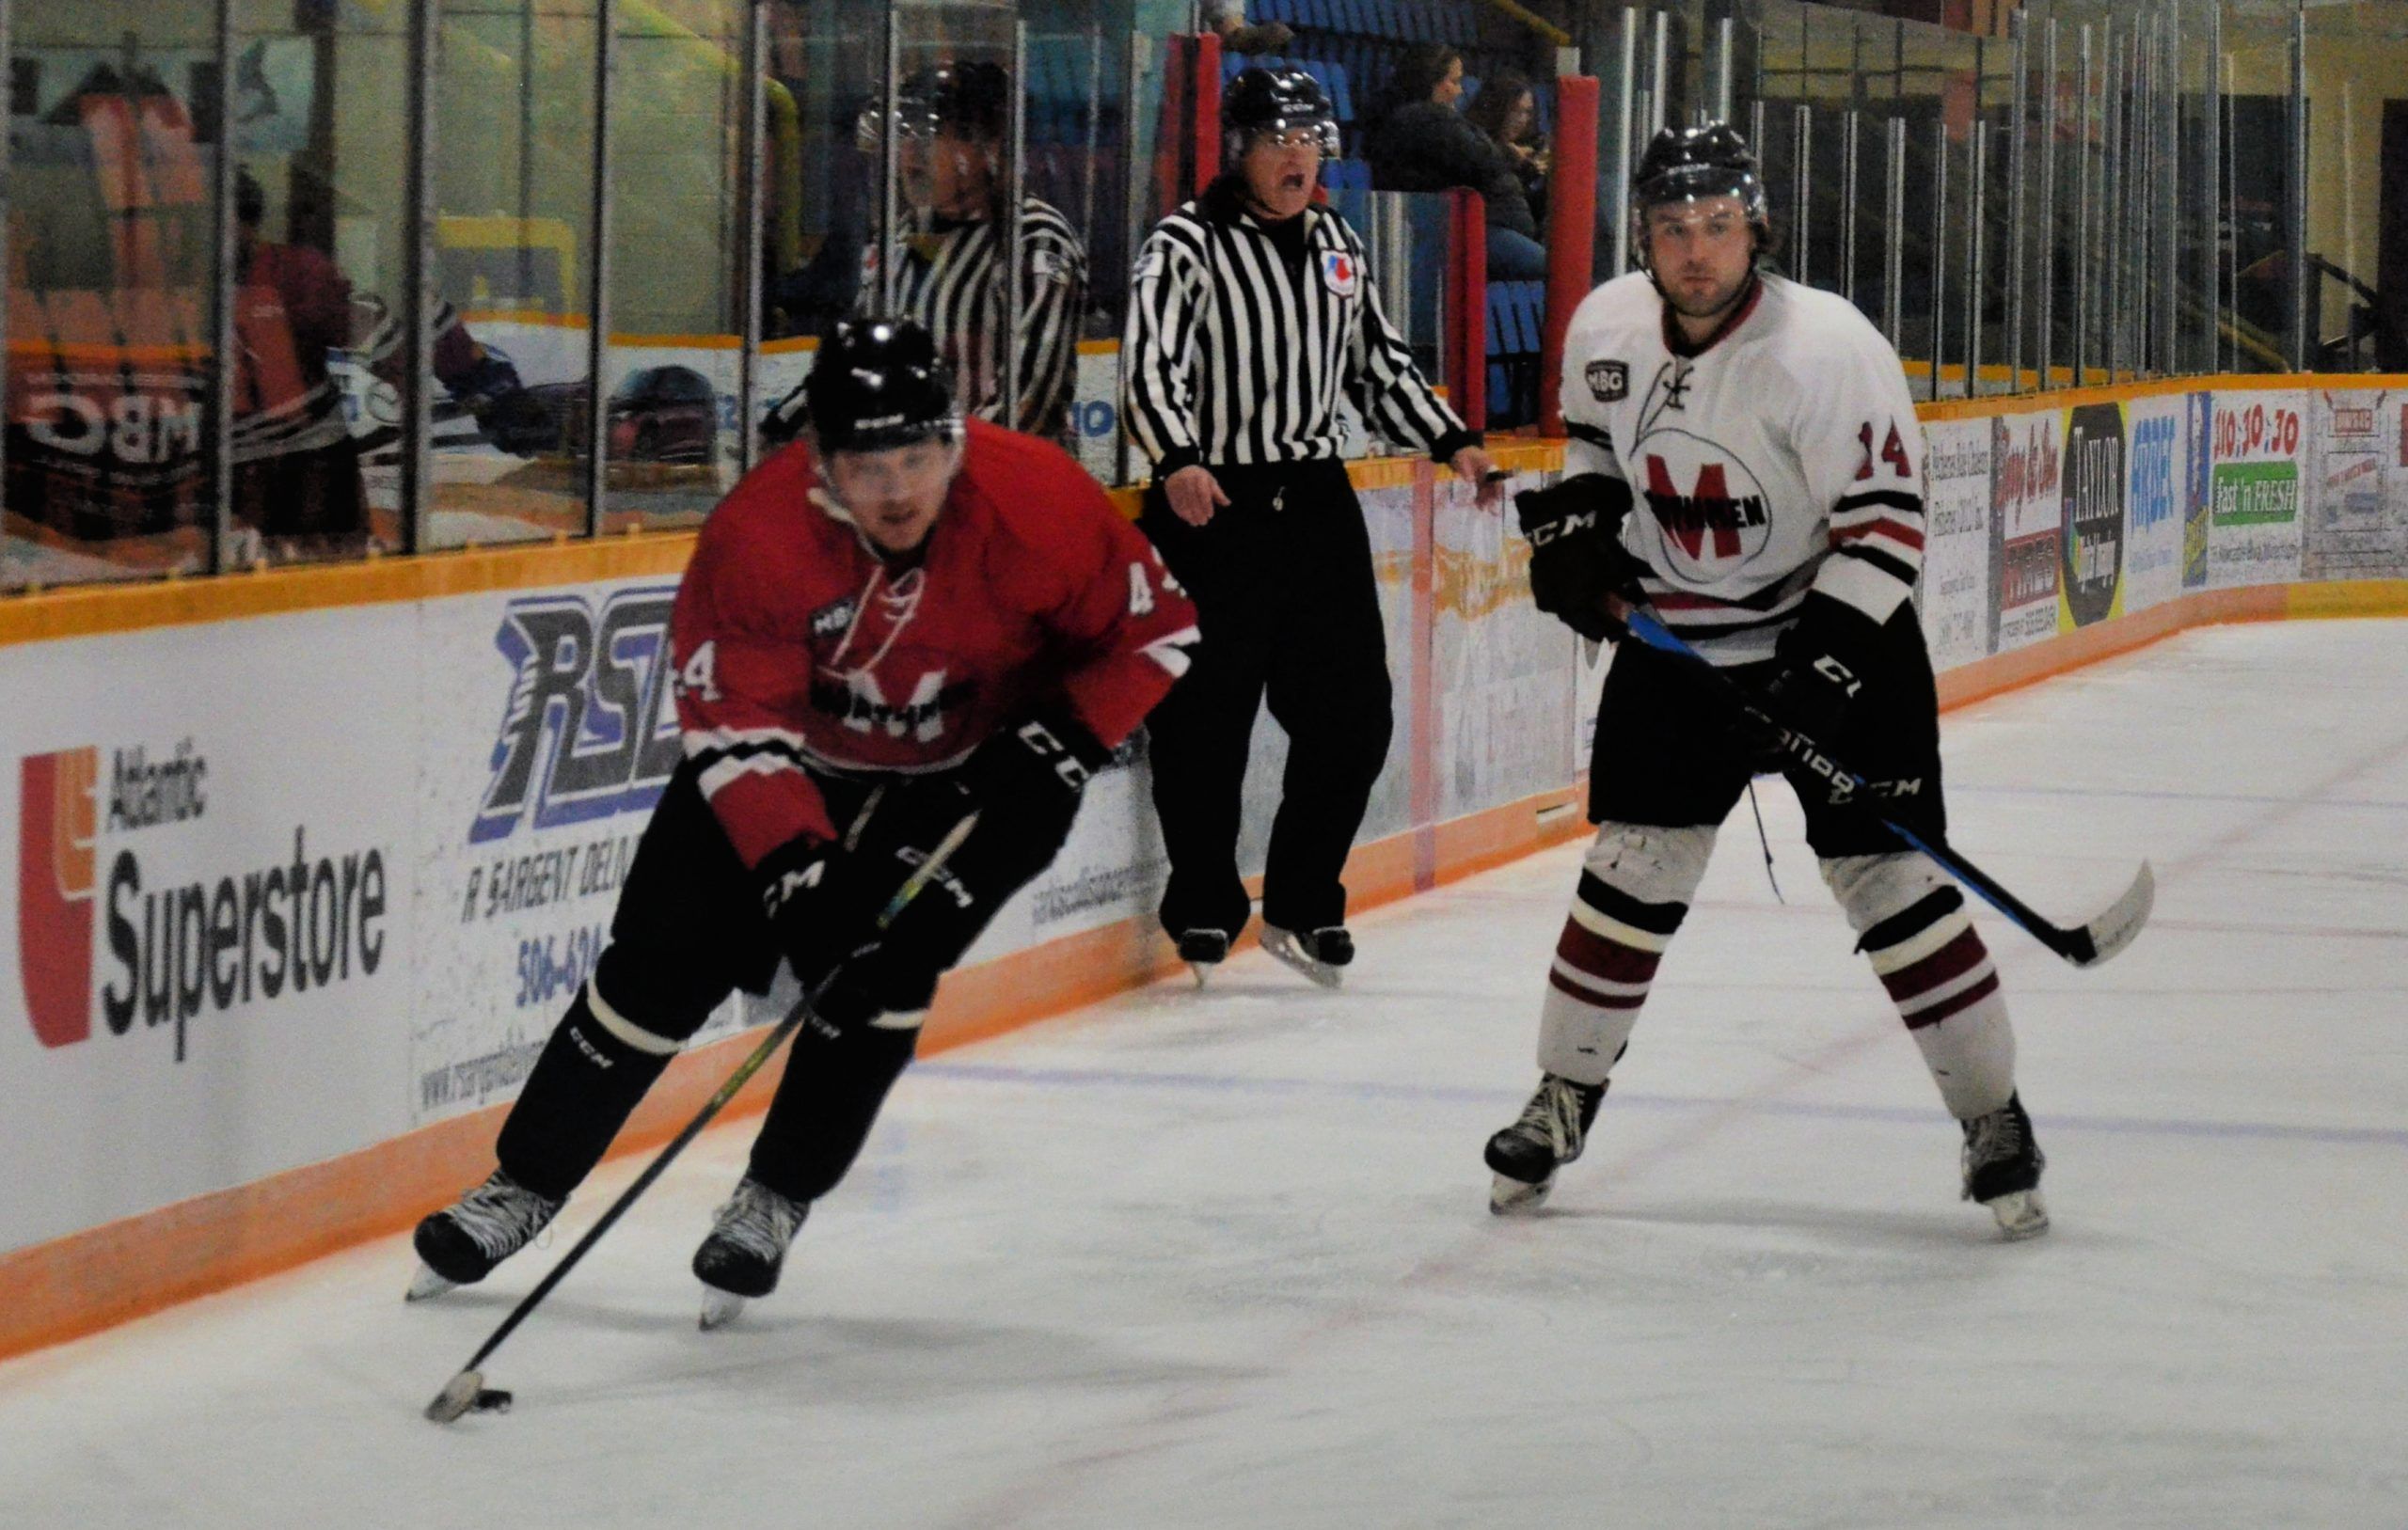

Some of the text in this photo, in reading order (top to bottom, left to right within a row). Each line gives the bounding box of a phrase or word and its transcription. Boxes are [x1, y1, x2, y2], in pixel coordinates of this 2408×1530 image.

[1854, 414, 1912, 481] 14
[2074, 426, 2119, 523] TAYLOR
[1525, 510, 1596, 546] CM
[2255, 479, 2297, 512] FRESH
[107, 738, 207, 834] Atlantic
[1017, 720, 1092, 793] CC
[485, 845, 579, 920] SARGENT
[103, 825, 387, 1063] Superstore
